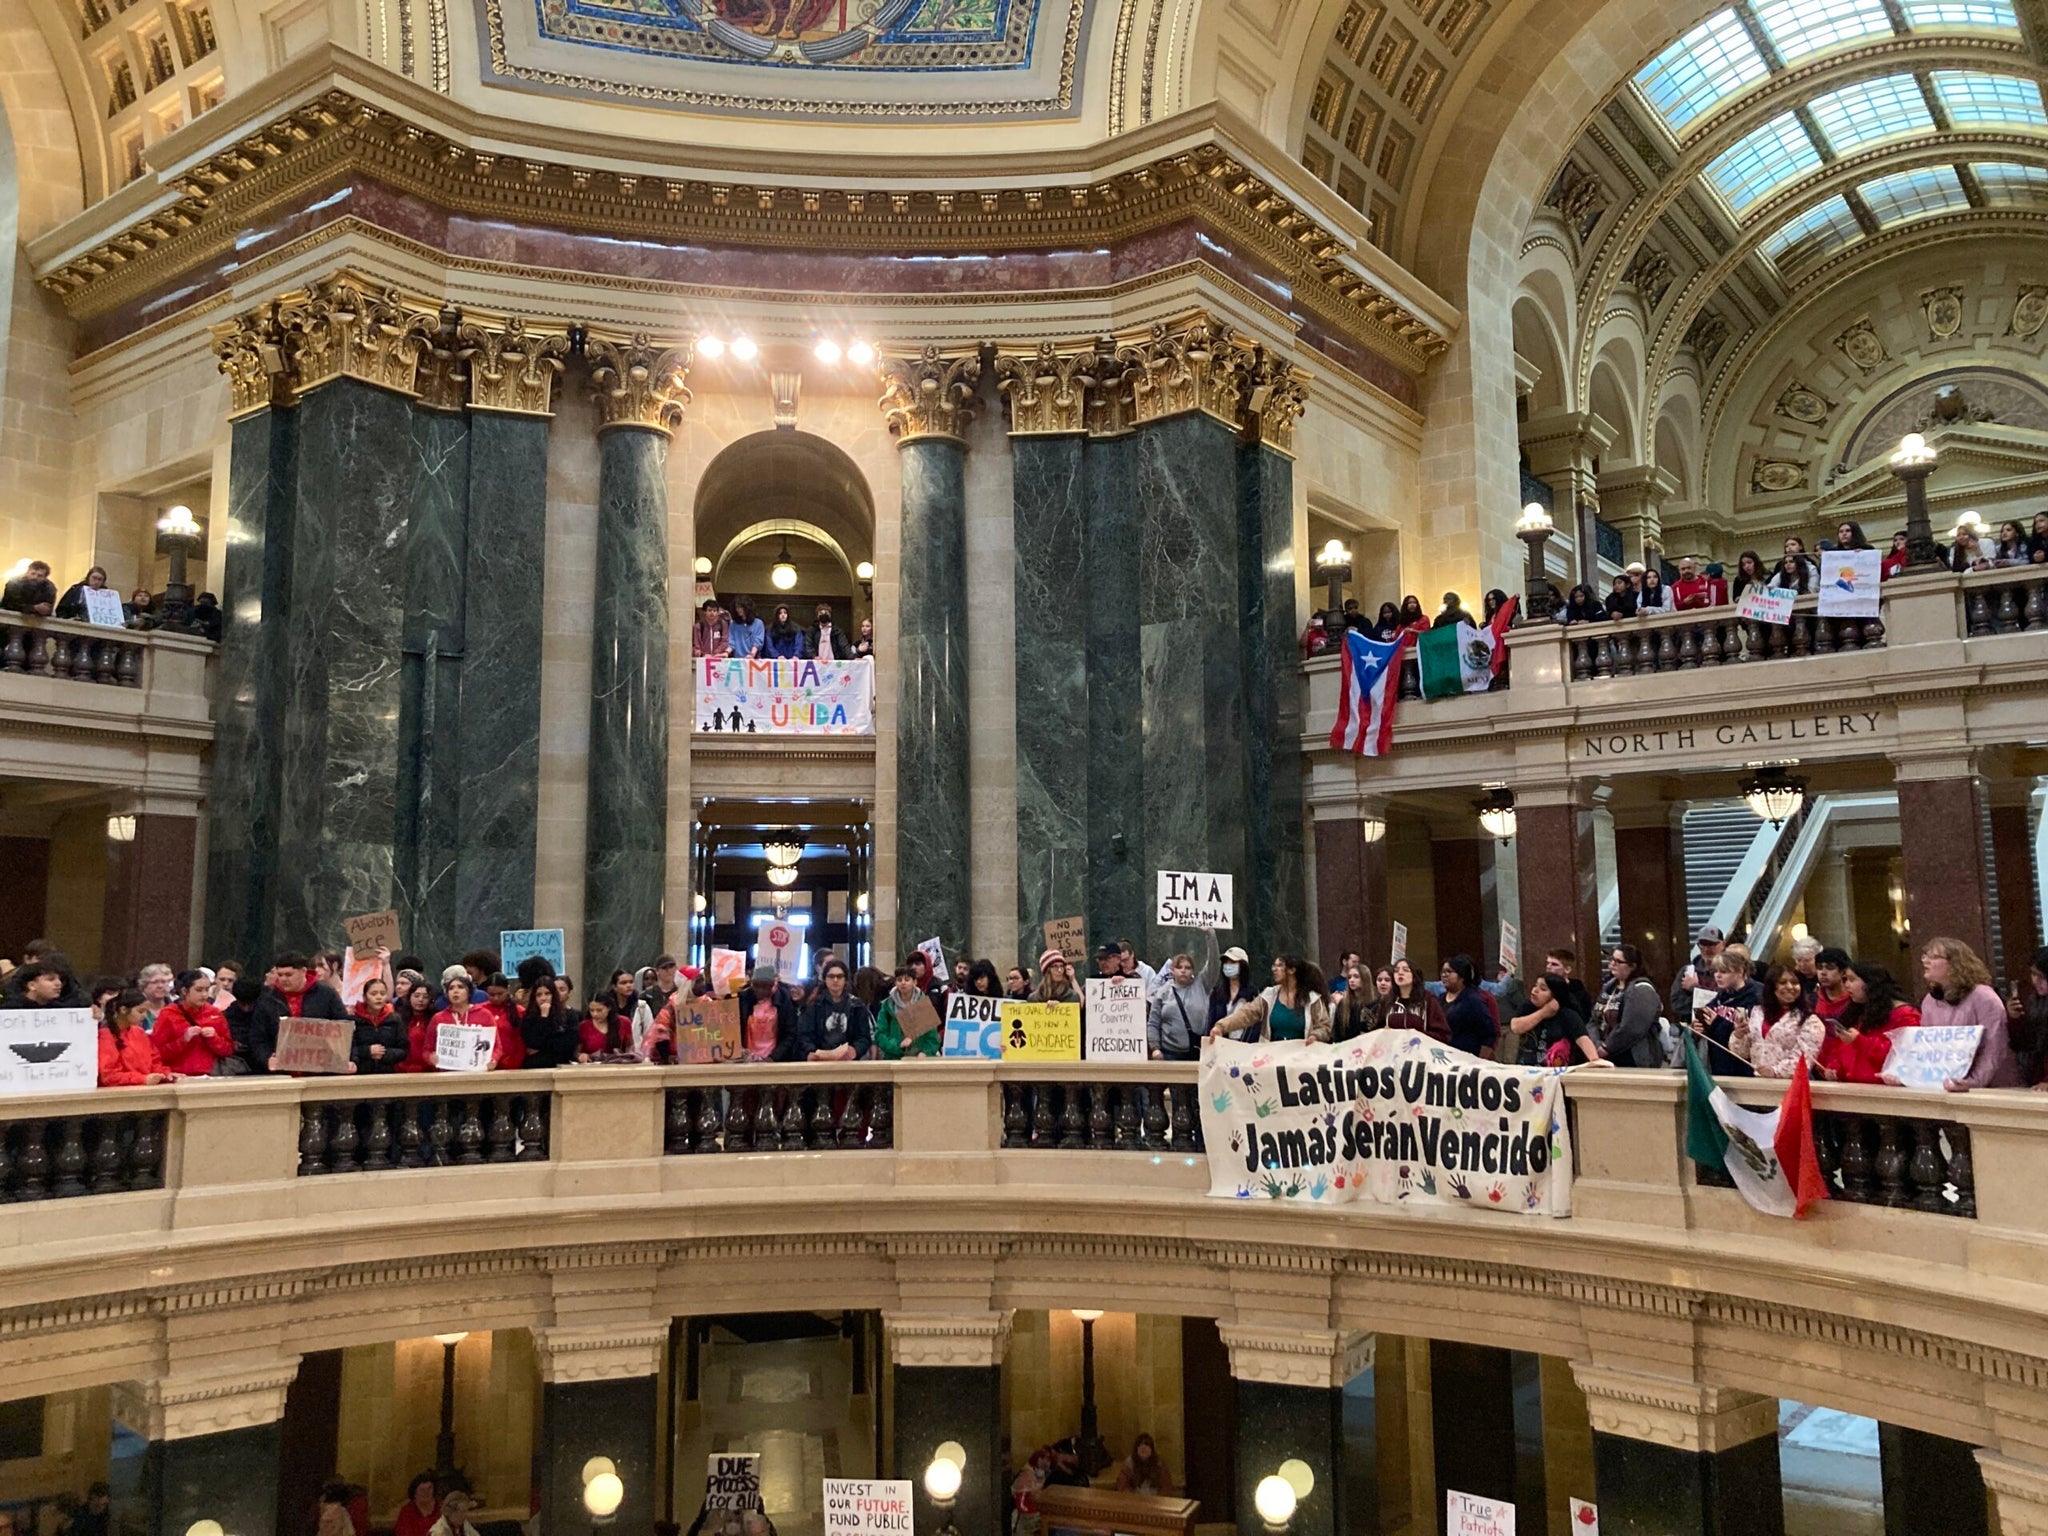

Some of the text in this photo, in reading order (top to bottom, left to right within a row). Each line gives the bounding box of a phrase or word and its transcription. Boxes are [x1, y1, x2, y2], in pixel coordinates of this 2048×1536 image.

[706, 659, 820, 688] FAMILIA
[771, 703, 847, 727] UNIDA
[1586, 711, 1881, 756] NORTH GALLERY
[1165, 873, 1222, 902] IM A
[1202, 909, 1219, 922] not
[1057, 920, 1071, 929] NO
[503, 932, 561, 948] FASCISM
[1050, 929, 1083, 940] HUMAN
[1058, 938, 1072, 950] IS
[1109, 984, 1140, 999] THREAT
[950, 996, 1002, 1022] ABOL
[1009, 1006, 1072, 1016] THE OVAL OFFICE
[1093, 1002, 1130, 1013] TO OUR
[677, 1008, 704, 1026] We
[1044, 1020, 1060, 1029] NOW
[1064, 1020, 1069, 1028] A
[1100, 1013, 1134, 1024] COUNTRY
[691, 1026, 724, 1041] The
[945, 1020, 1002, 1060] IC
[1028, 1033, 1076, 1049] DAYCARE
[1091, 1036, 1144, 1053] PRESIDENT
[1400, 1060, 1521, 1112] Unidos
[1245, 1109, 1552, 1176] Jamás Serán Vencido
[718, 1457, 753, 1475] DUE
[826, 1483, 896, 1496] INVEST IN
[709, 1494, 732, 1511] for
[829, 1498, 909, 1514] OUR FUTURE.
[1460, 1496, 1492, 1516] True
[829, 1513, 909, 1530] FUND PUBLIC
[1460, 1515, 1505, 1536] Patriots
